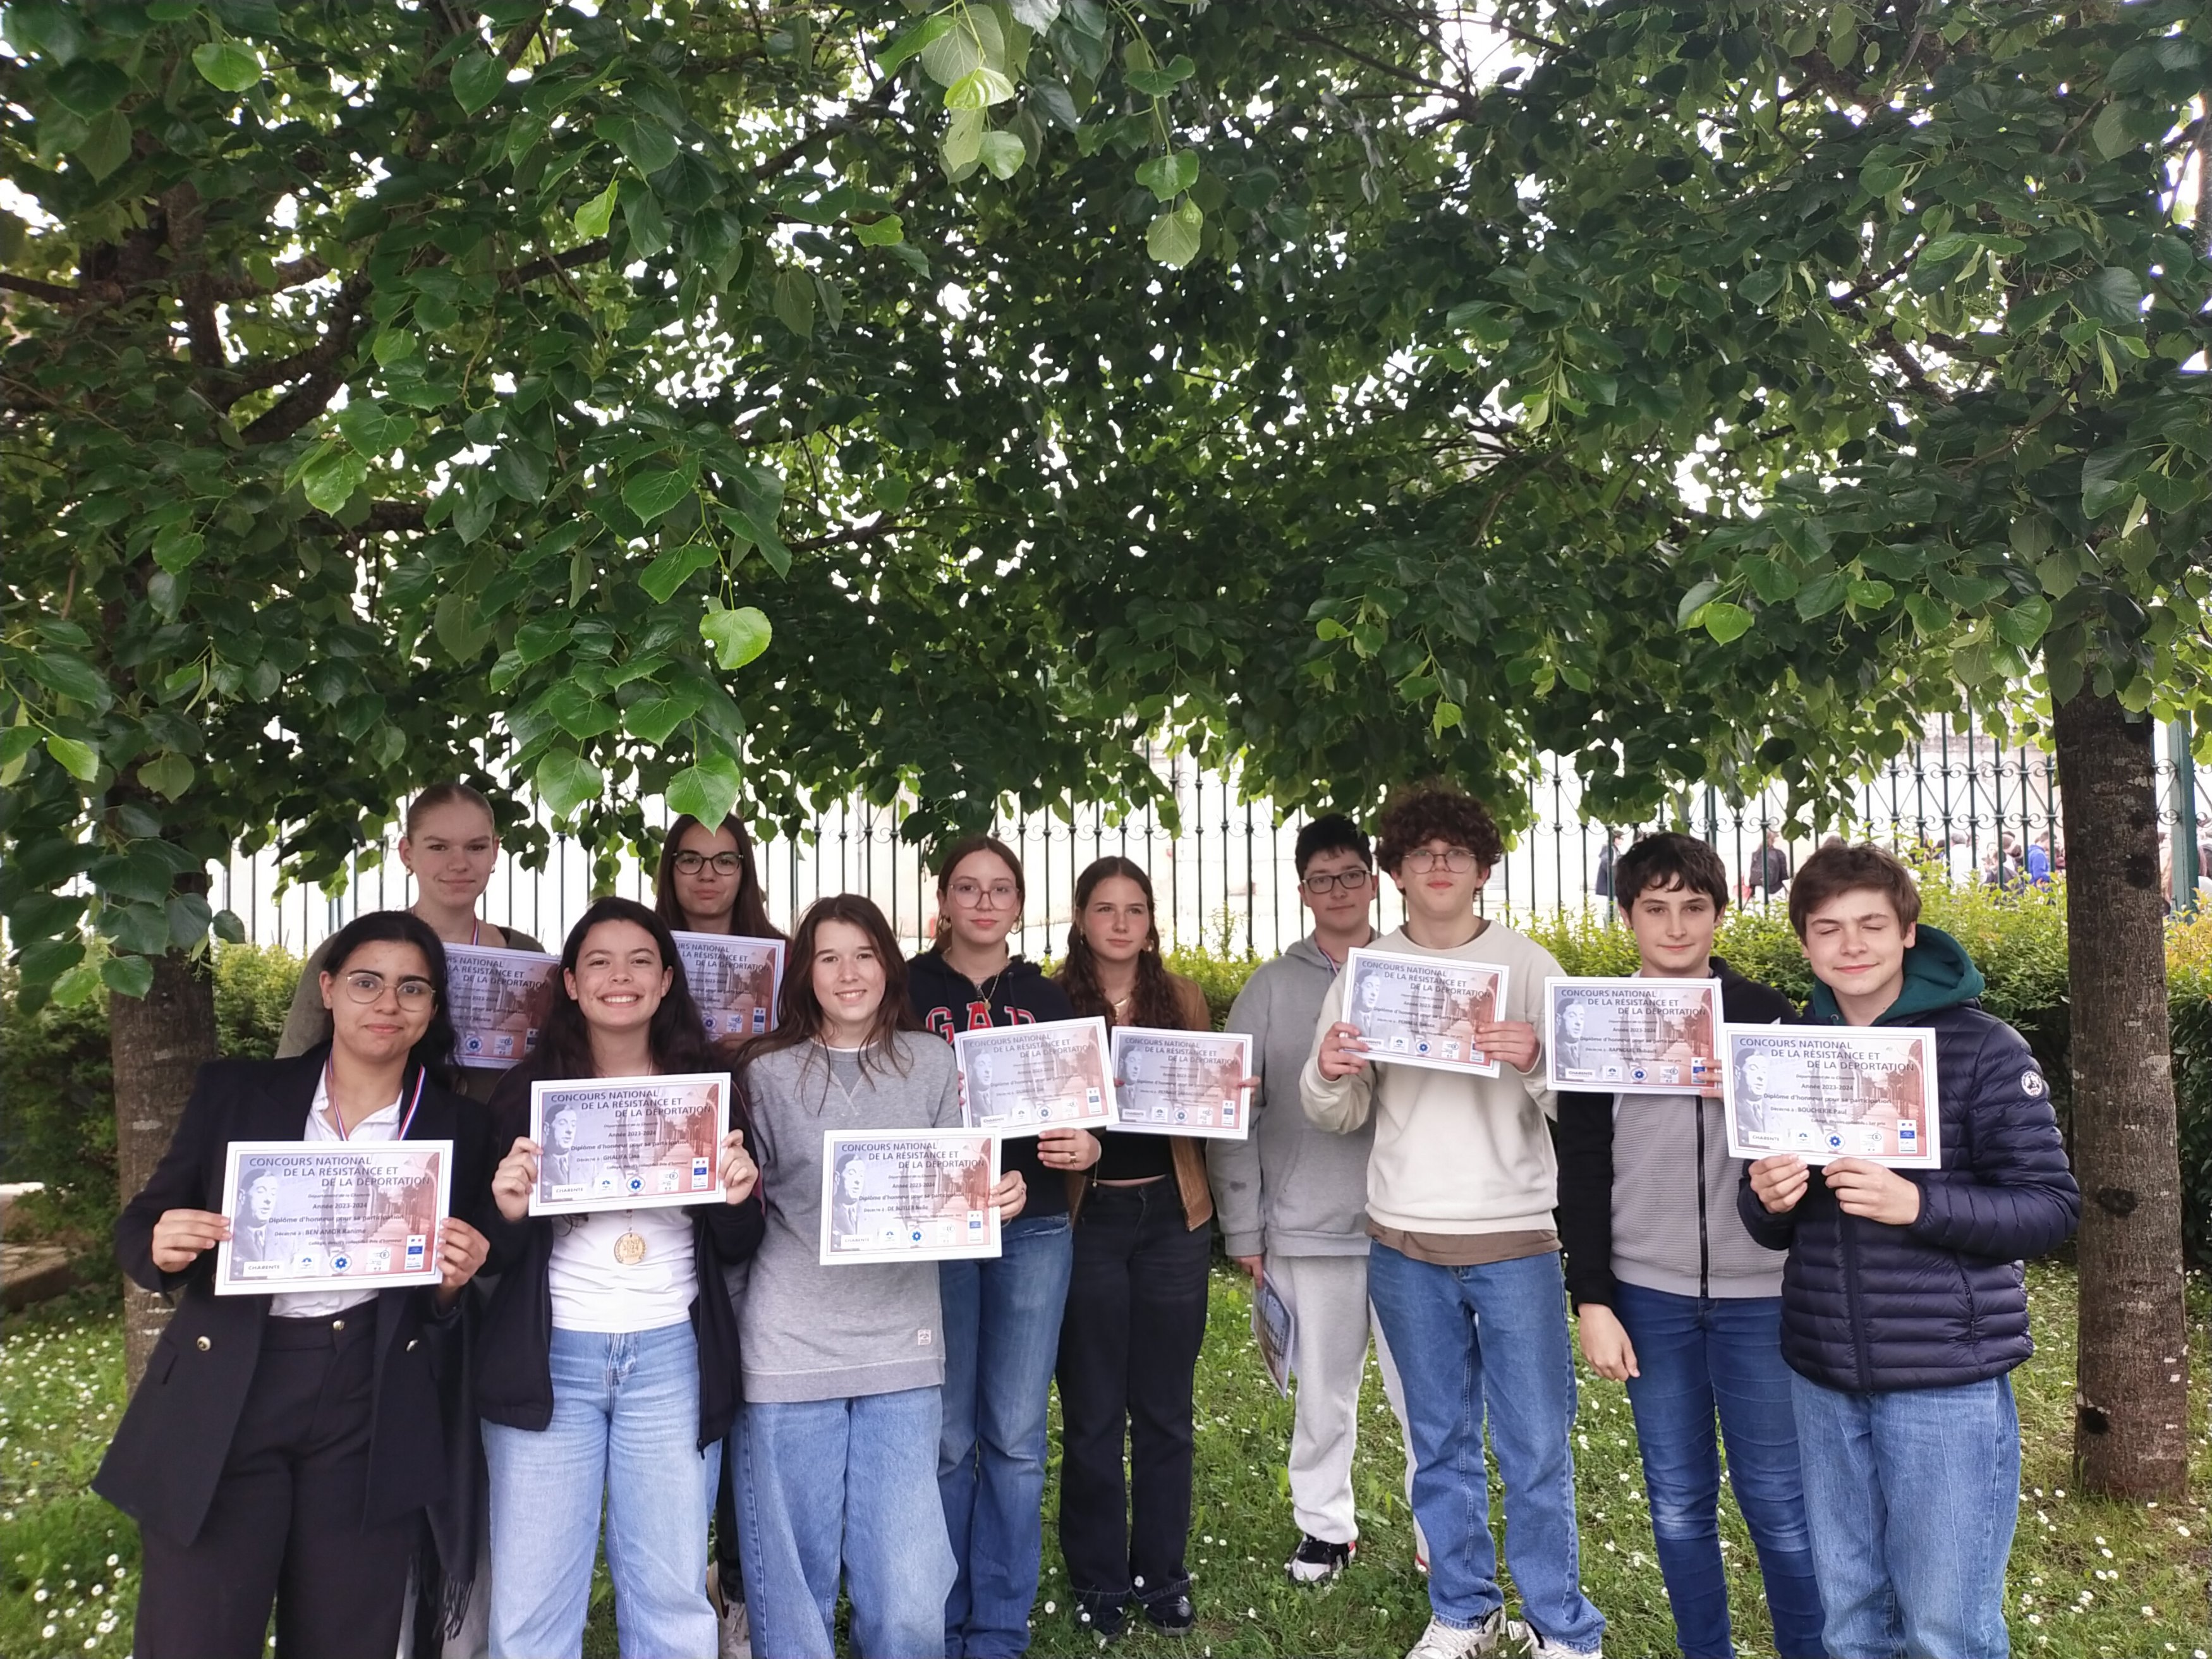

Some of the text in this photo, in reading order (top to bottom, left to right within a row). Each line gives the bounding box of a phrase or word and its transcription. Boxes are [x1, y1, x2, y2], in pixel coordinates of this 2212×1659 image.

[691, 944, 729, 952] NATIONAL
[459, 956, 504, 968] NATIONAL
[1361, 960, 1447, 977] CONCOURS NATIONAL
[1408, 974, 1454, 986] RÉSISTANCE
[1615, 998, 1665, 1006] RÉSISTANCE
[969, 1033, 1050, 1048] CONCOURS NATIONAL
[1739, 1038, 1852, 1049] CONCOURS NATIONAL
[1803, 1049, 1864, 1060] RÉSISTANCE
[1807, 1060, 1820, 1068] DE
[550, 1090, 658, 1102] CONCOURS NATIONAL
[1850, 1097, 1891, 1105] participation
[612, 1098, 668, 1109] RÉSISTANCE
[841, 1142, 937, 1152] CONCOURS NATIONAL
[896, 1151, 945, 1160] RÉSISTANCE
[249, 1157, 372, 1166] CONCOURS NATIONAL
[283, 1166, 399, 1176] DE LA RÉSISTANCE ET
[321, 1178, 335, 1186] DE
[339, 1178, 353, 1186] LA
[362, 1213, 404, 1222] participation
